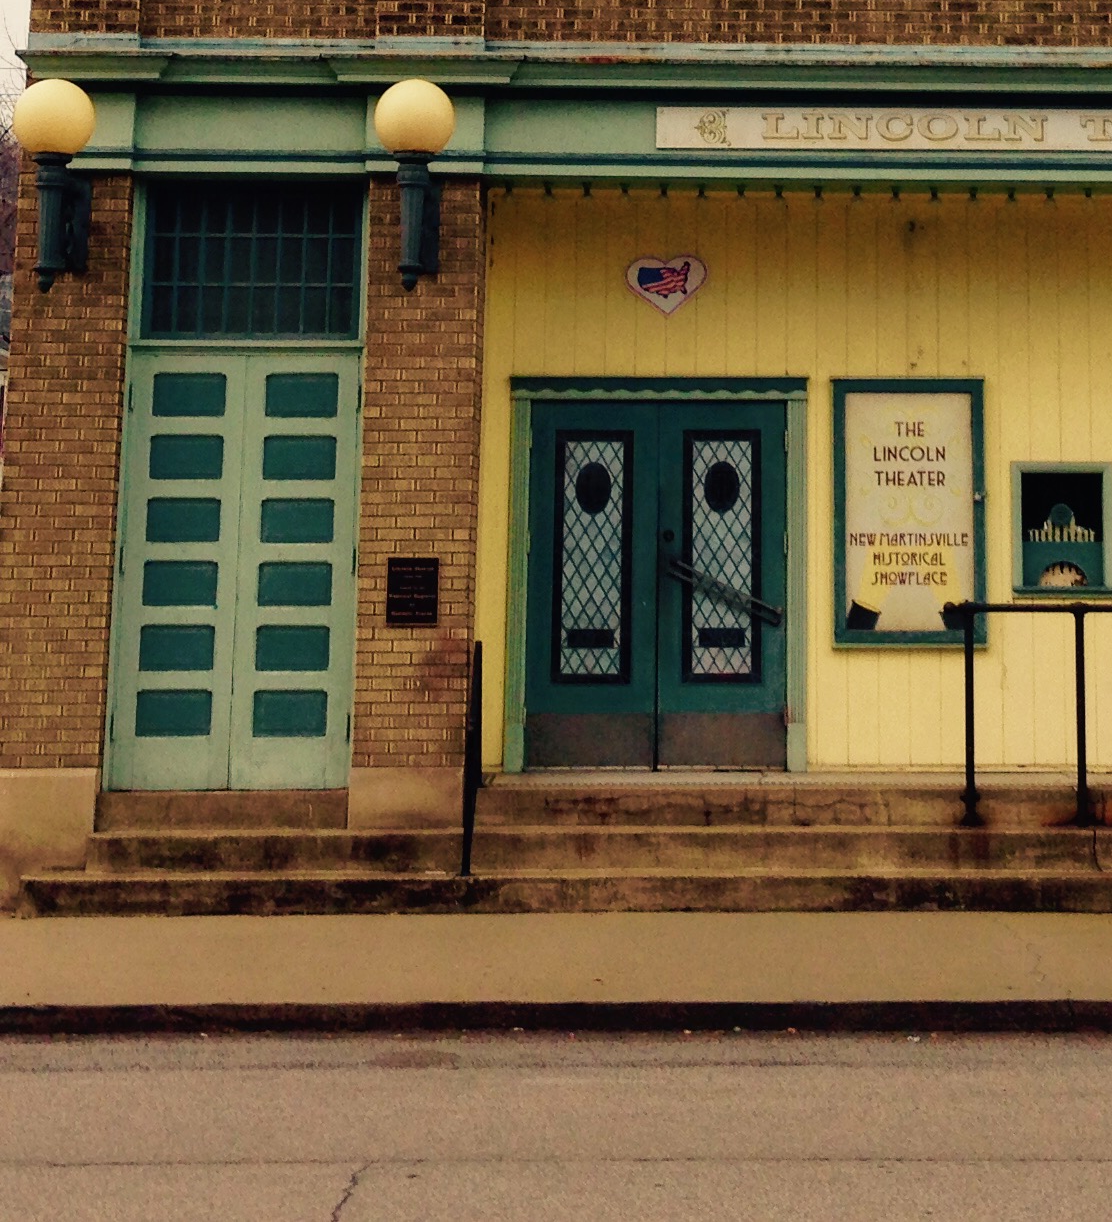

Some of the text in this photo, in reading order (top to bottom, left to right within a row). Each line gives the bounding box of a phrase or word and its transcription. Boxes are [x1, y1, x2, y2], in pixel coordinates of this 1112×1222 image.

[761, 112, 1049, 142] LINCOLN
[894, 421, 925, 438] THE
[873, 446, 946, 462] LINCOLN
[874, 470, 946, 487] THEATER
[849, 532, 969, 547] NEW MARTINSVILLE
[872, 552, 946, 566] HISTORICAL
[871, 571, 948, 586] SHOWPLACE
